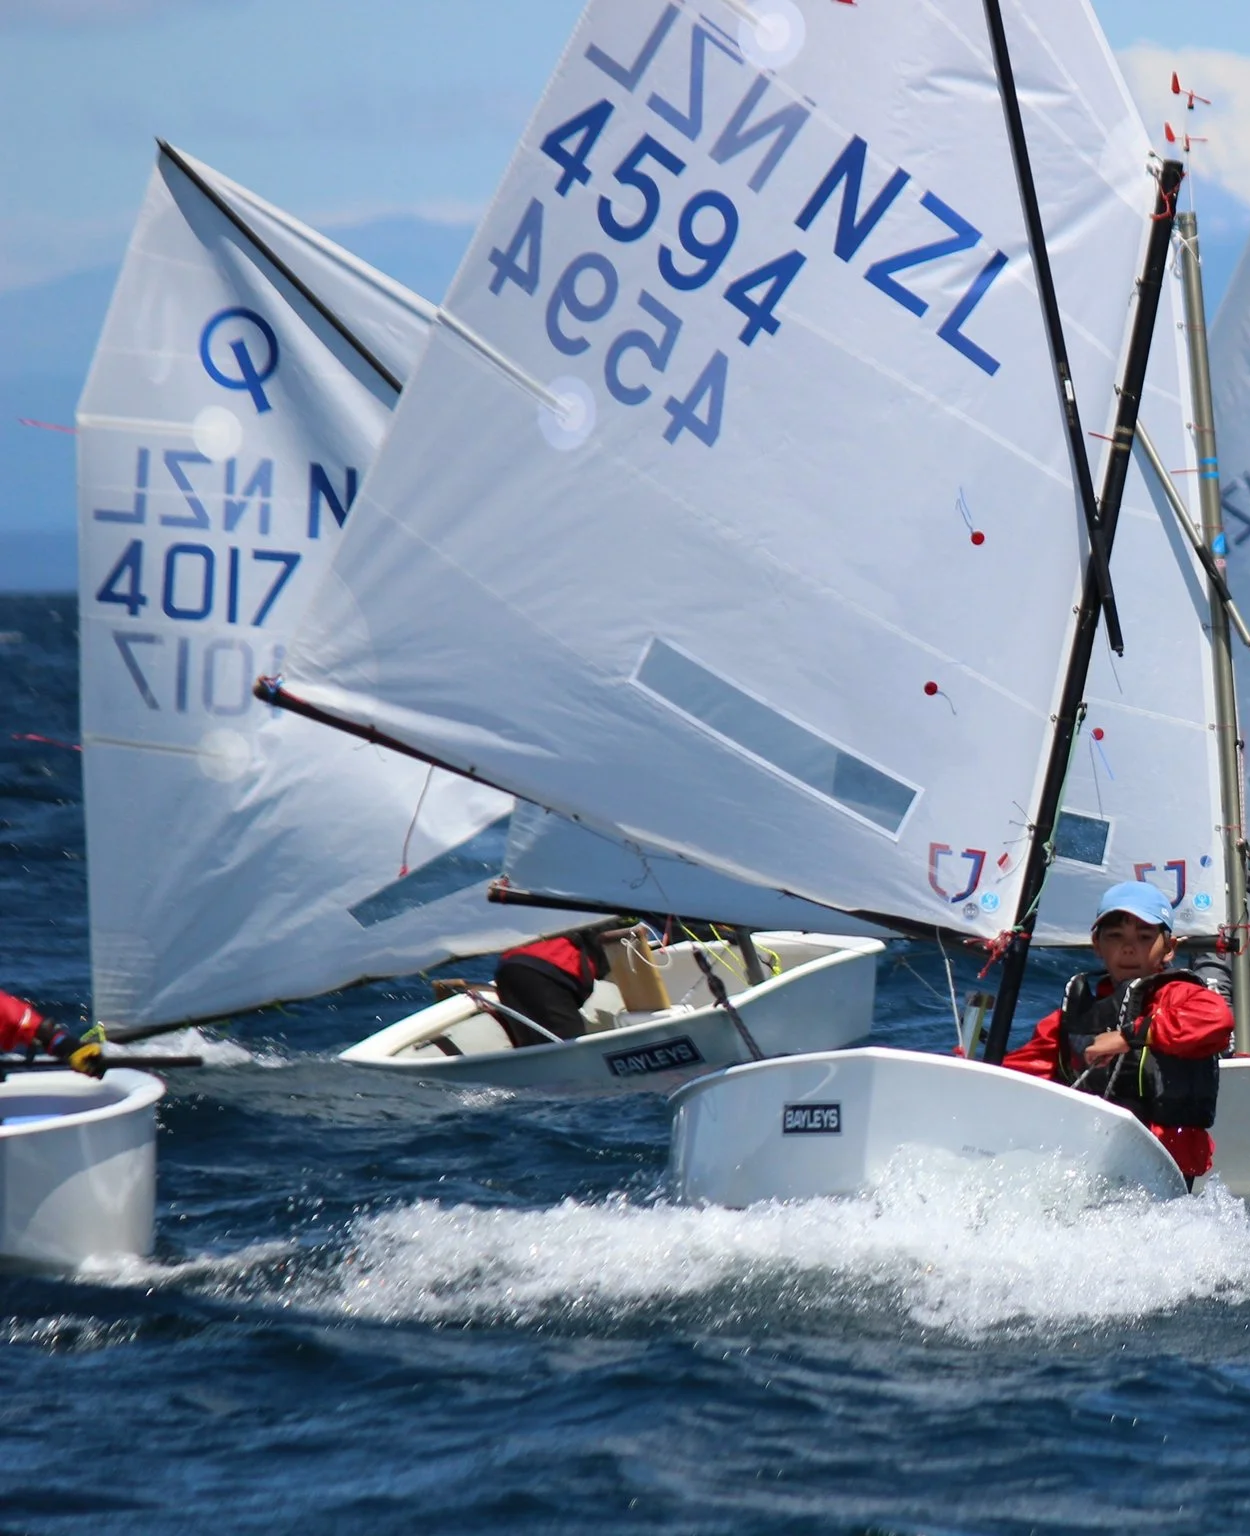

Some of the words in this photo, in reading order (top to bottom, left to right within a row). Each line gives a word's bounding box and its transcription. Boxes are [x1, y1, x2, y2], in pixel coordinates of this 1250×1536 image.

[540, 98, 806, 347] 4594
[795, 134, 1009, 377] NZL
[95, 538, 302, 627] 4017
[613, 1044, 694, 1077] BAYLEYS
[784, 1108, 839, 1131] BAYLEYS
